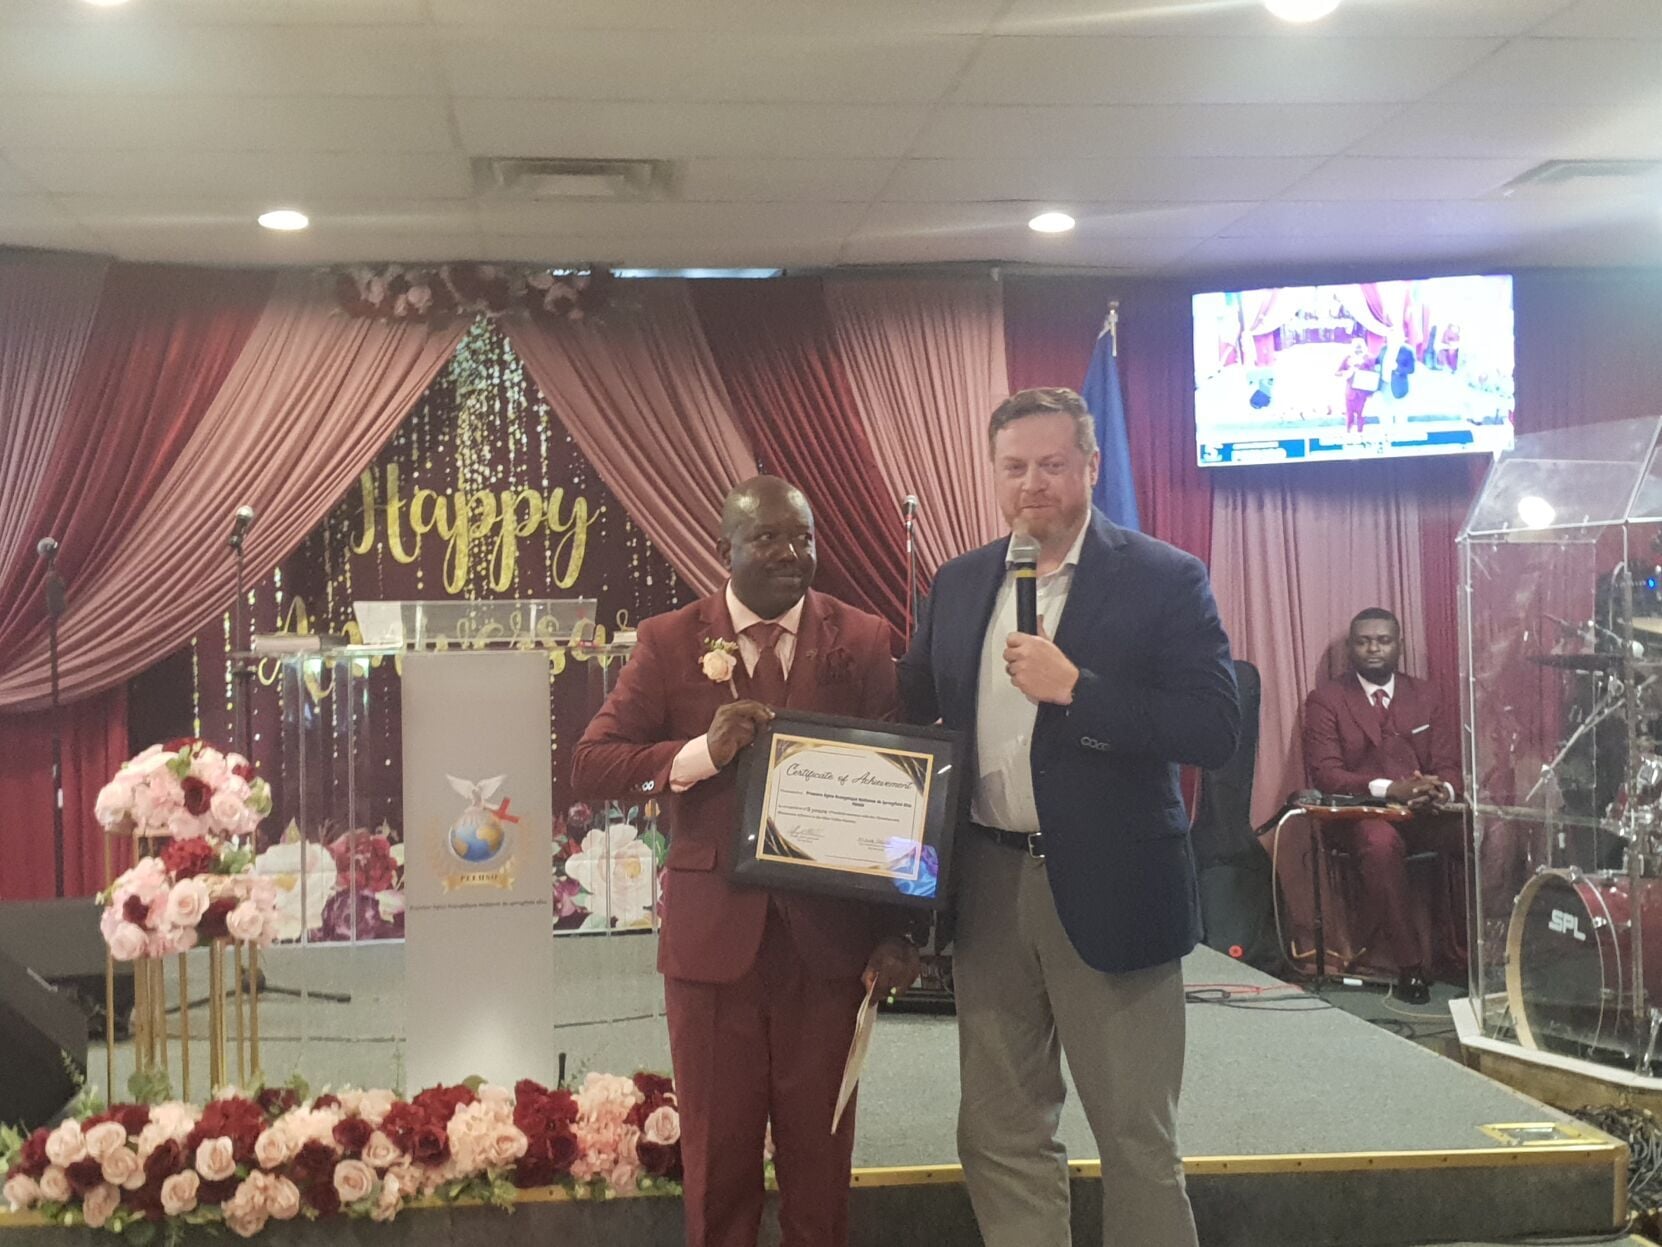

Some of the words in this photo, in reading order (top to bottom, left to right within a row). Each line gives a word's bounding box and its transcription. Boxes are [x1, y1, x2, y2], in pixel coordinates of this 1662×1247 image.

[351, 463, 601, 594] Happy
[786, 762, 834, 781] Certificate
[837, 774, 849, 786] of
[851, 771, 913, 790] Achievement
[1548, 909, 1586, 942] SPL
